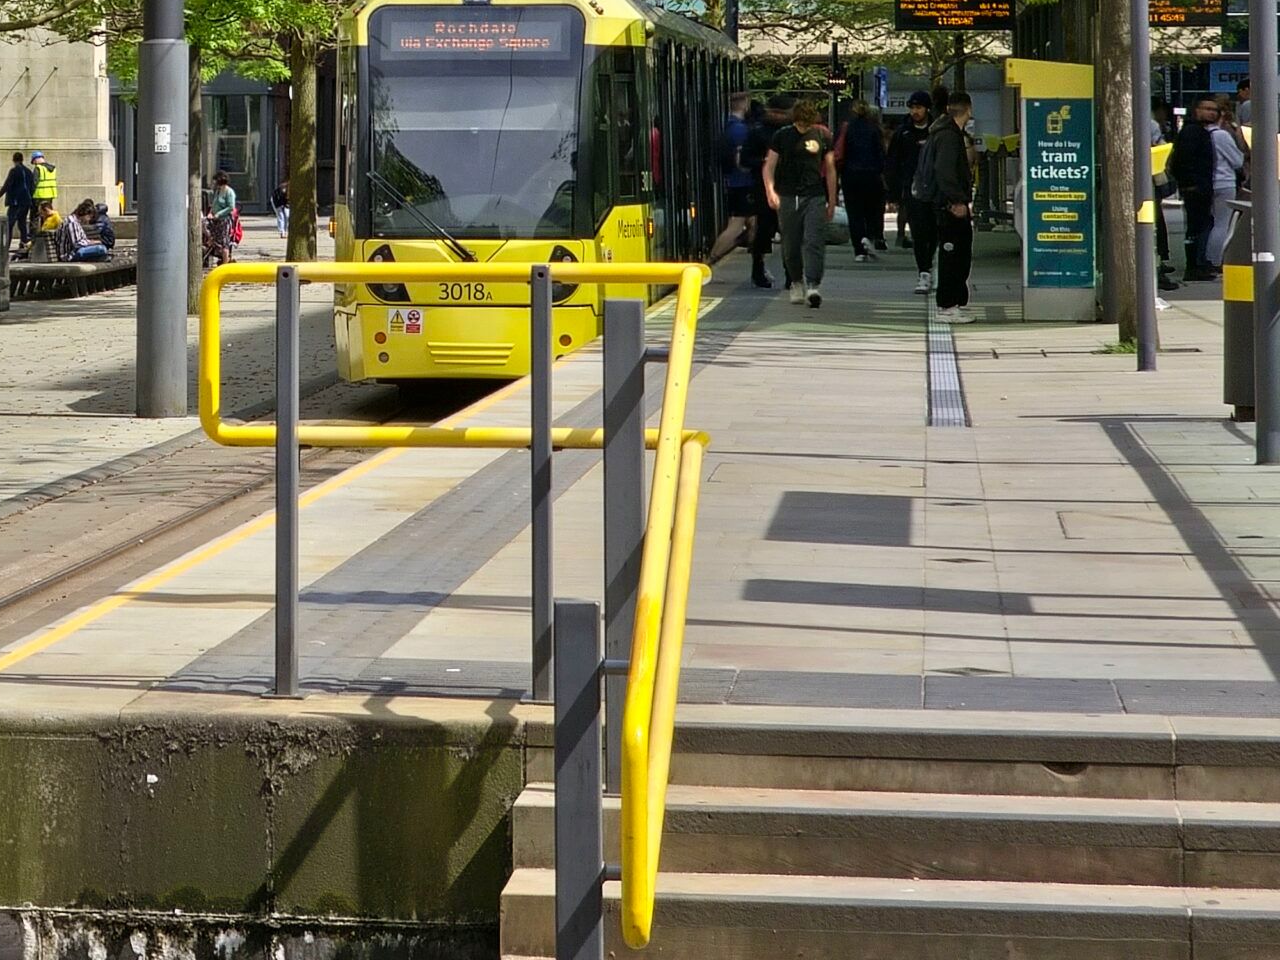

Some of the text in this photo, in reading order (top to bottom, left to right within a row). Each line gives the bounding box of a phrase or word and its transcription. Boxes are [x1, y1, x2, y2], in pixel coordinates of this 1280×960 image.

[435, 21, 516, 34] Rochdale
[400, 36, 550, 51] via Exchange Square
[1068, 141, 1081, 149] buy
[1041, 150, 1077, 163] tram
[1030, 165, 1089, 179] tickets?
